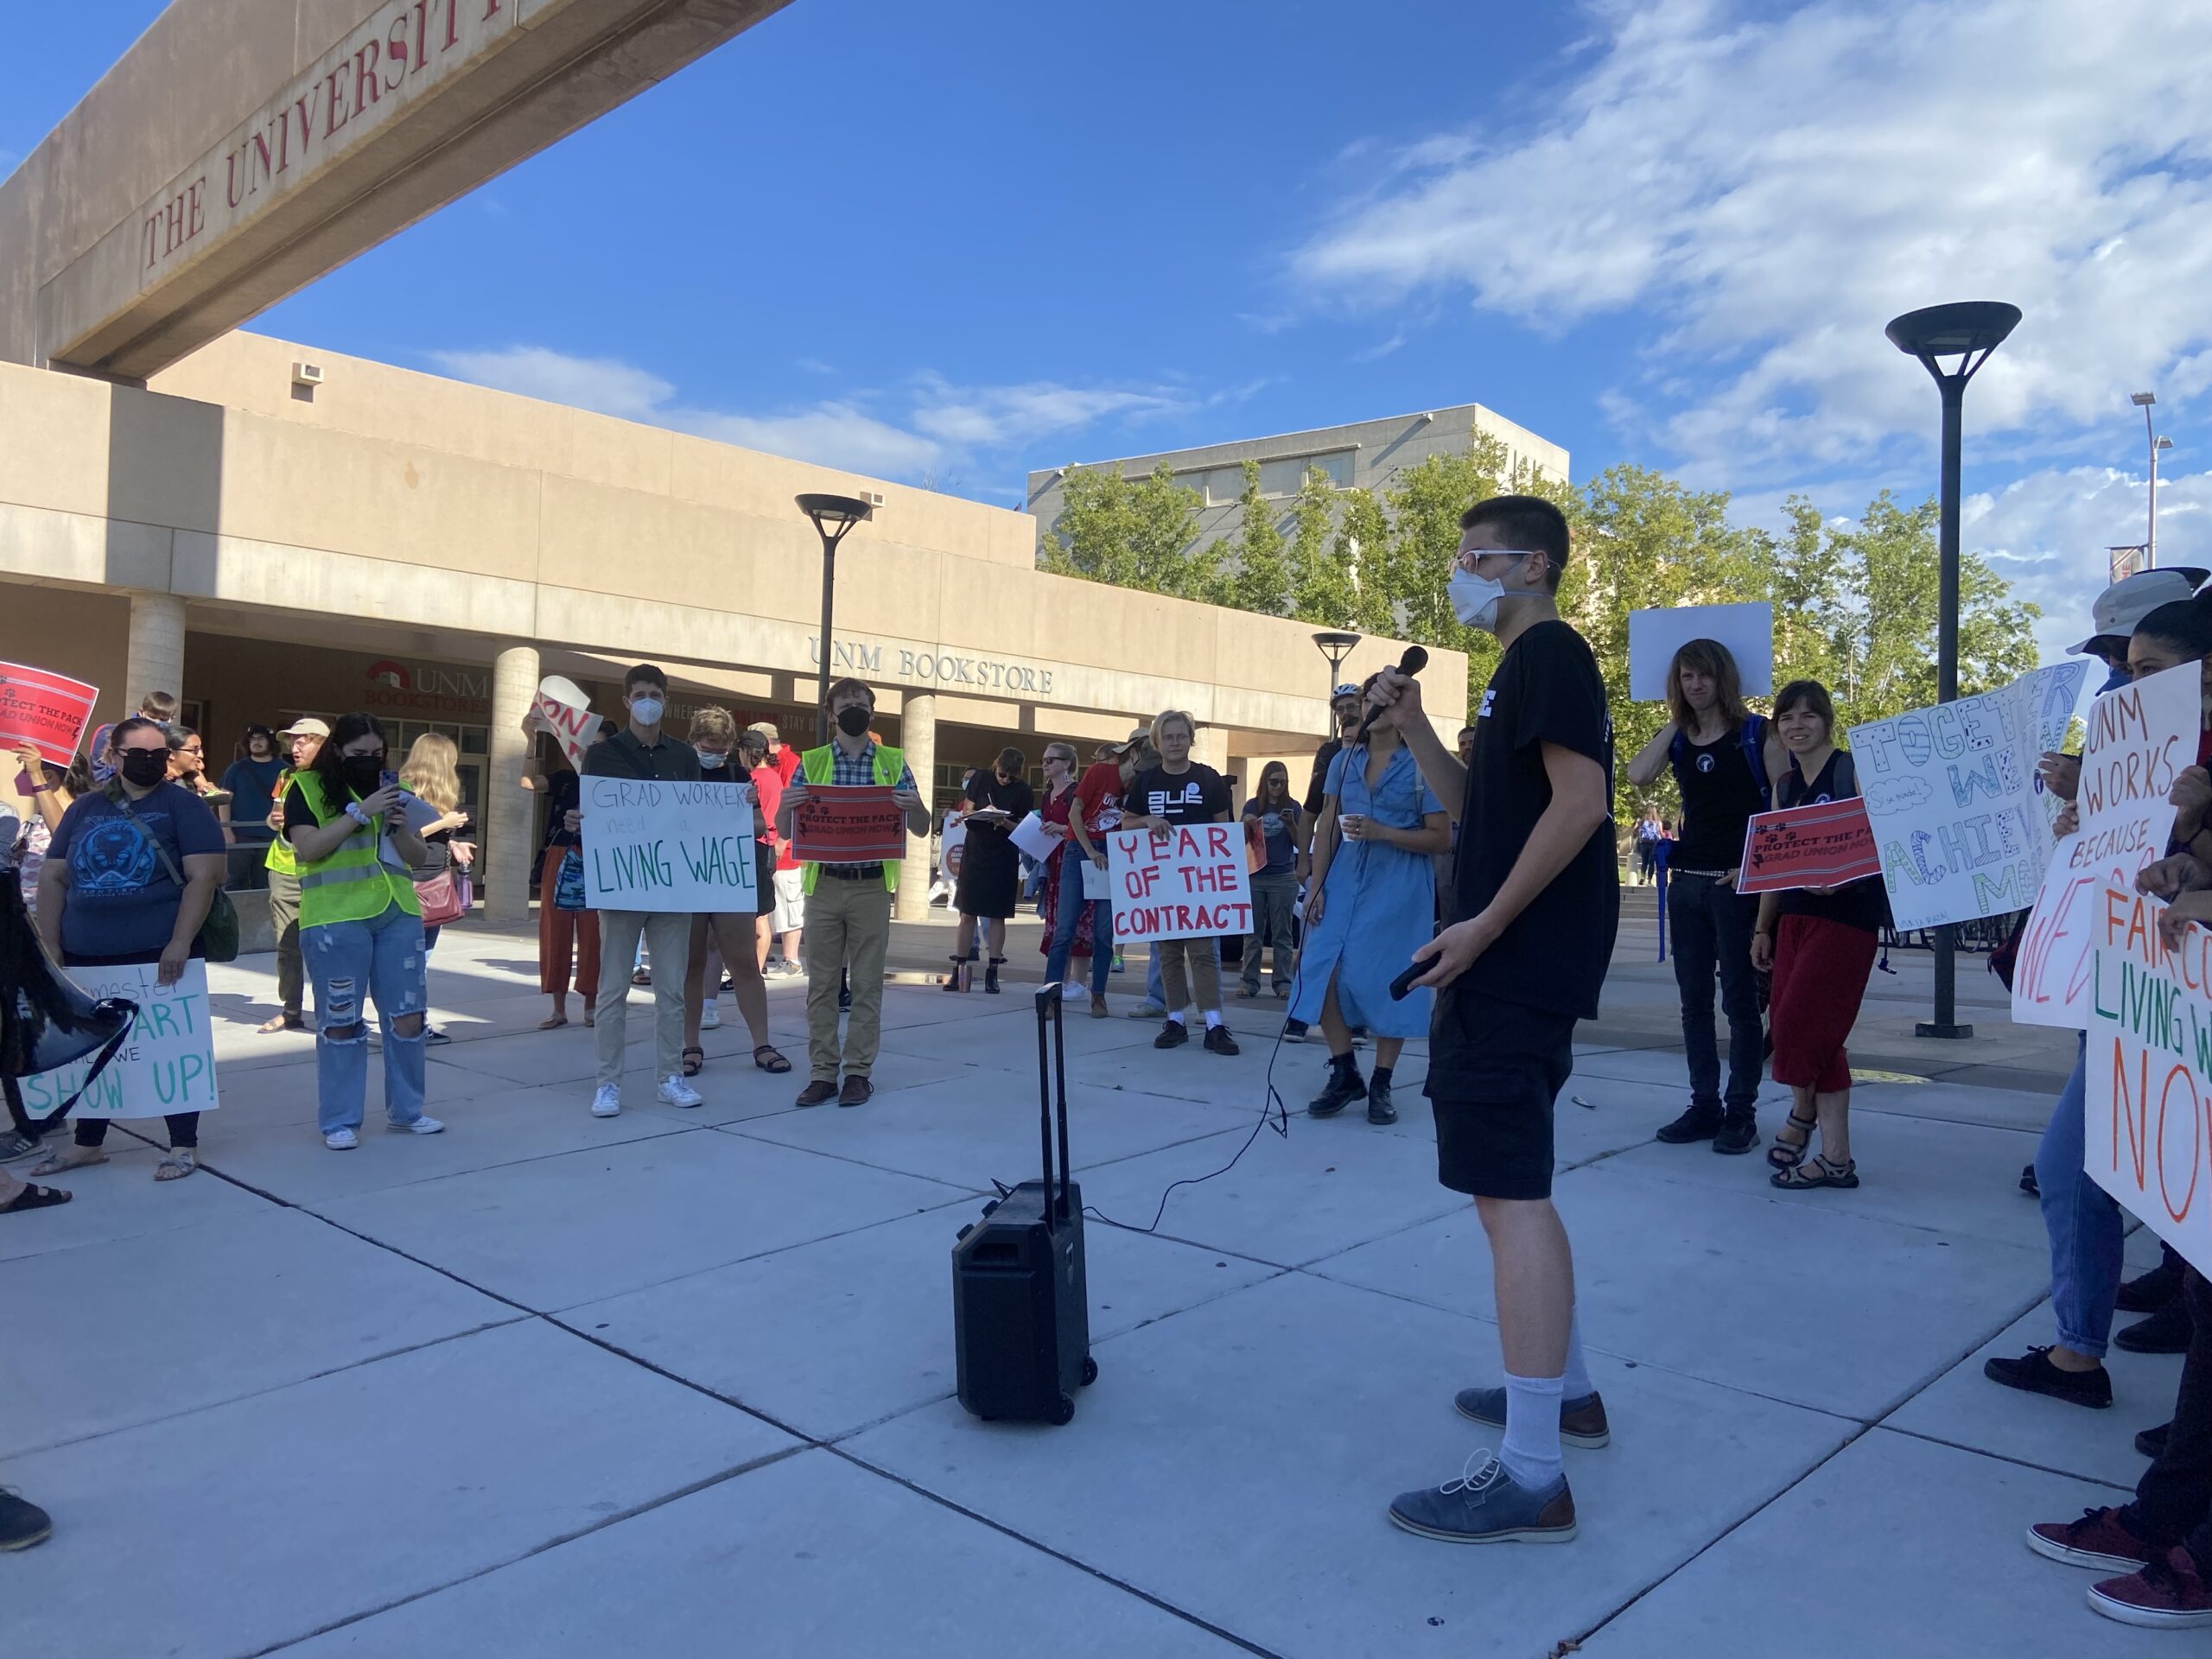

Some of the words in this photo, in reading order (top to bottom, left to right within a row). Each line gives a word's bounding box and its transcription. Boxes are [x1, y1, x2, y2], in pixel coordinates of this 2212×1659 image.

[143, 175, 207, 270] THE
[226, 0, 501, 209] UNIVERSIT
[808, 636, 881, 671] UNM
[899, 649, 1053, 694] BOOKSTORE
[415, 668, 490, 699] UNM
[39, 704, 61, 718] THE
[60, 712, 84, 726] PACK
[364, 690, 490, 714] BOOKSTORES
[19, 712, 54, 728] UNION
[782, 714, 804, 733] STAY
[2088, 688, 2148, 755] UNM
[1947, 745, 2023, 809] WE
[2083, 734, 2179, 817] WORKS
[592, 779, 662, 808] GRAD
[607, 815, 647, 834] need
[679, 820, 691, 832] a
[799, 813, 846, 824] PROTECT
[849, 815, 870, 823] THE
[872, 814, 900, 823] PACK
[804, 823, 833, 835] GRAD
[836, 826, 867, 835] UNION
[868, 825, 893, 834] NOW
[1118, 827, 1232, 864] YEAR
[1754, 836, 1821, 853] PROTECT
[1824, 831, 1853, 844] THE
[1764, 849, 1801, 863] GRAD
[1802, 844, 1847, 858] UNION
[2069, 817, 2152, 869] BECAUSE
[594, 840, 673, 893] LIVING
[680, 835, 755, 888] WAGE
[1125, 866, 1160, 899] OF
[1178, 864, 1237, 893] THE
[1115, 903, 1251, 937] CONTRACT
[2019, 876, 2096, 1004] WE
[2095, 950, 2183, 1057] LIVING
[153, 1050, 215, 1104] UP!
